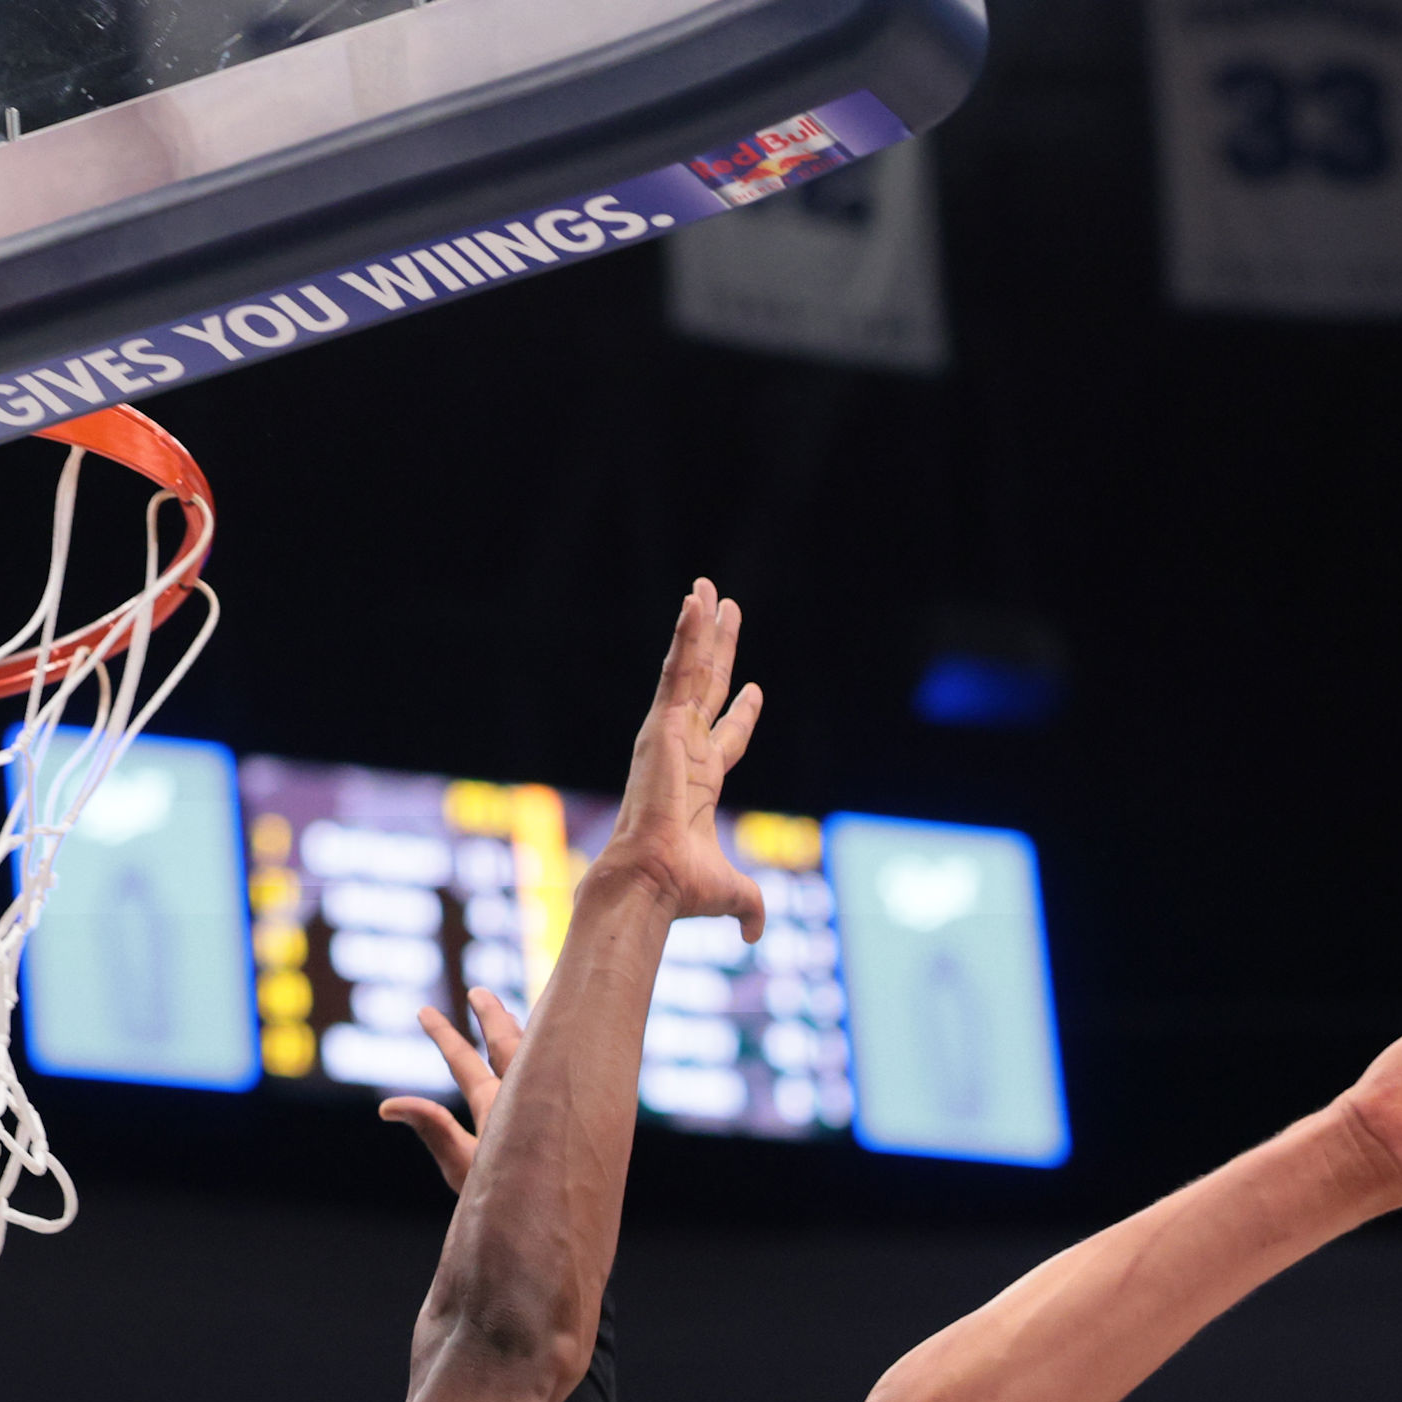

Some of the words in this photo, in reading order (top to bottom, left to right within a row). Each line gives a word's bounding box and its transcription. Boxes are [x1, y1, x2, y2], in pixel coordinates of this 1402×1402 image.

[1210, 54, 1397, 186] 33
[172, 284, 350, 362] YOU
[336, 193, 676, 311] WIIINGS.
